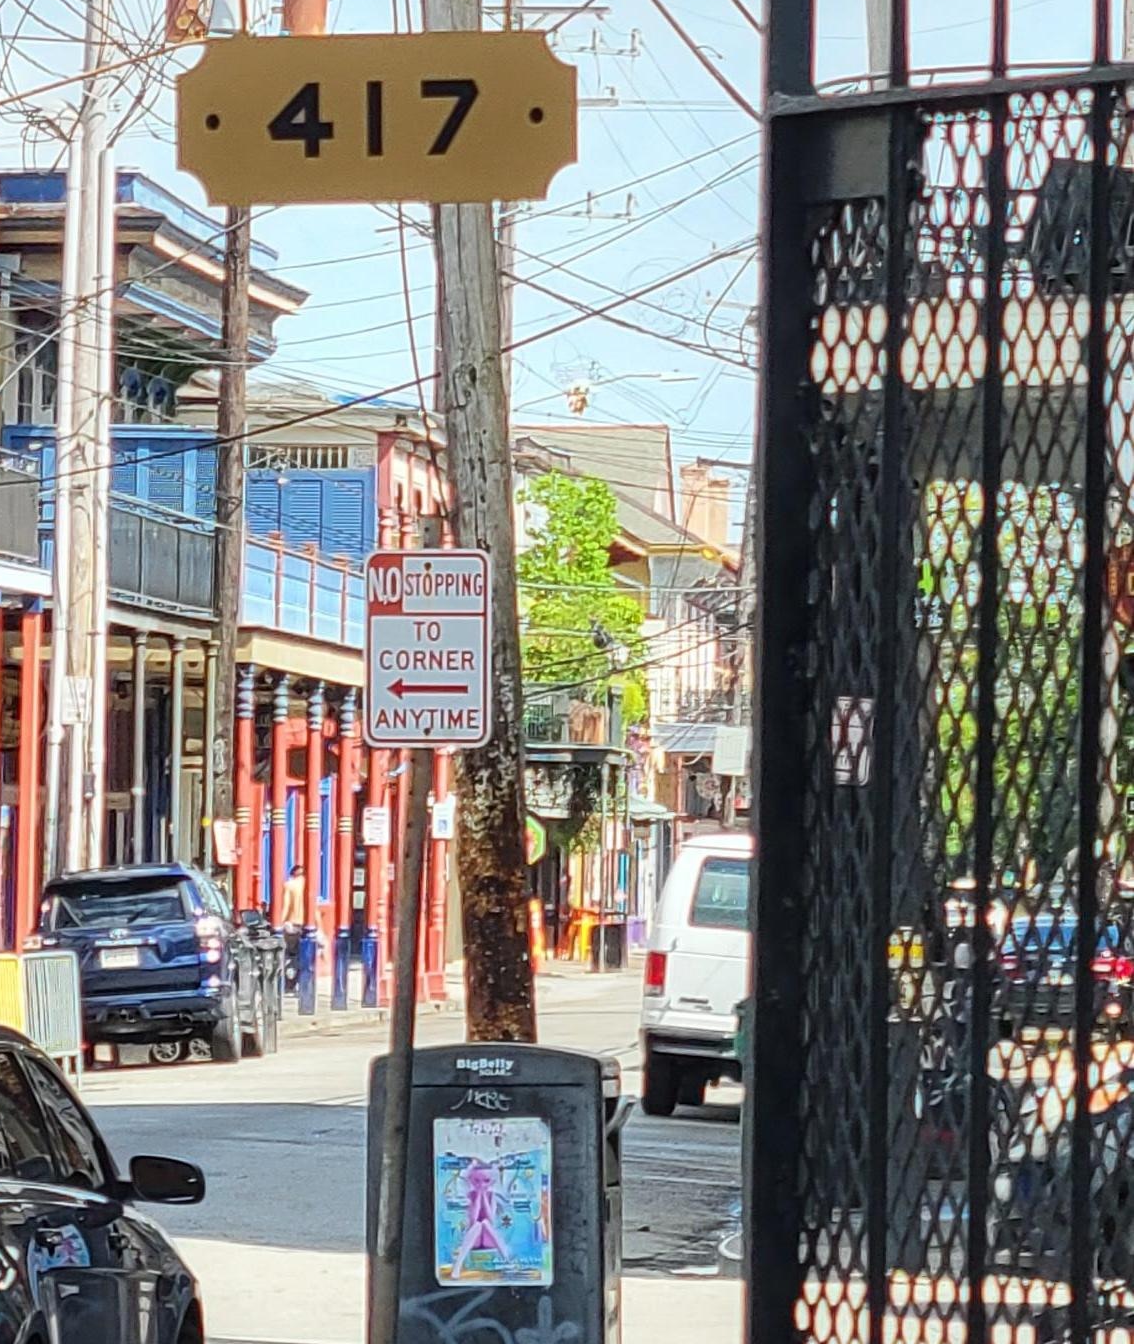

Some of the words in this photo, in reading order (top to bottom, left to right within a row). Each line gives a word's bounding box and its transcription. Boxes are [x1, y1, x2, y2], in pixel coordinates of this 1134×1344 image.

[267, 79, 479, 157] 417
[369, 566, 402, 603] NO
[404, 572, 483, 597] STOPPING
[413, 621, 441, 641] TO
[379, 650, 475, 671] CORNER
[374, 709, 480, 730] ANYTIME
